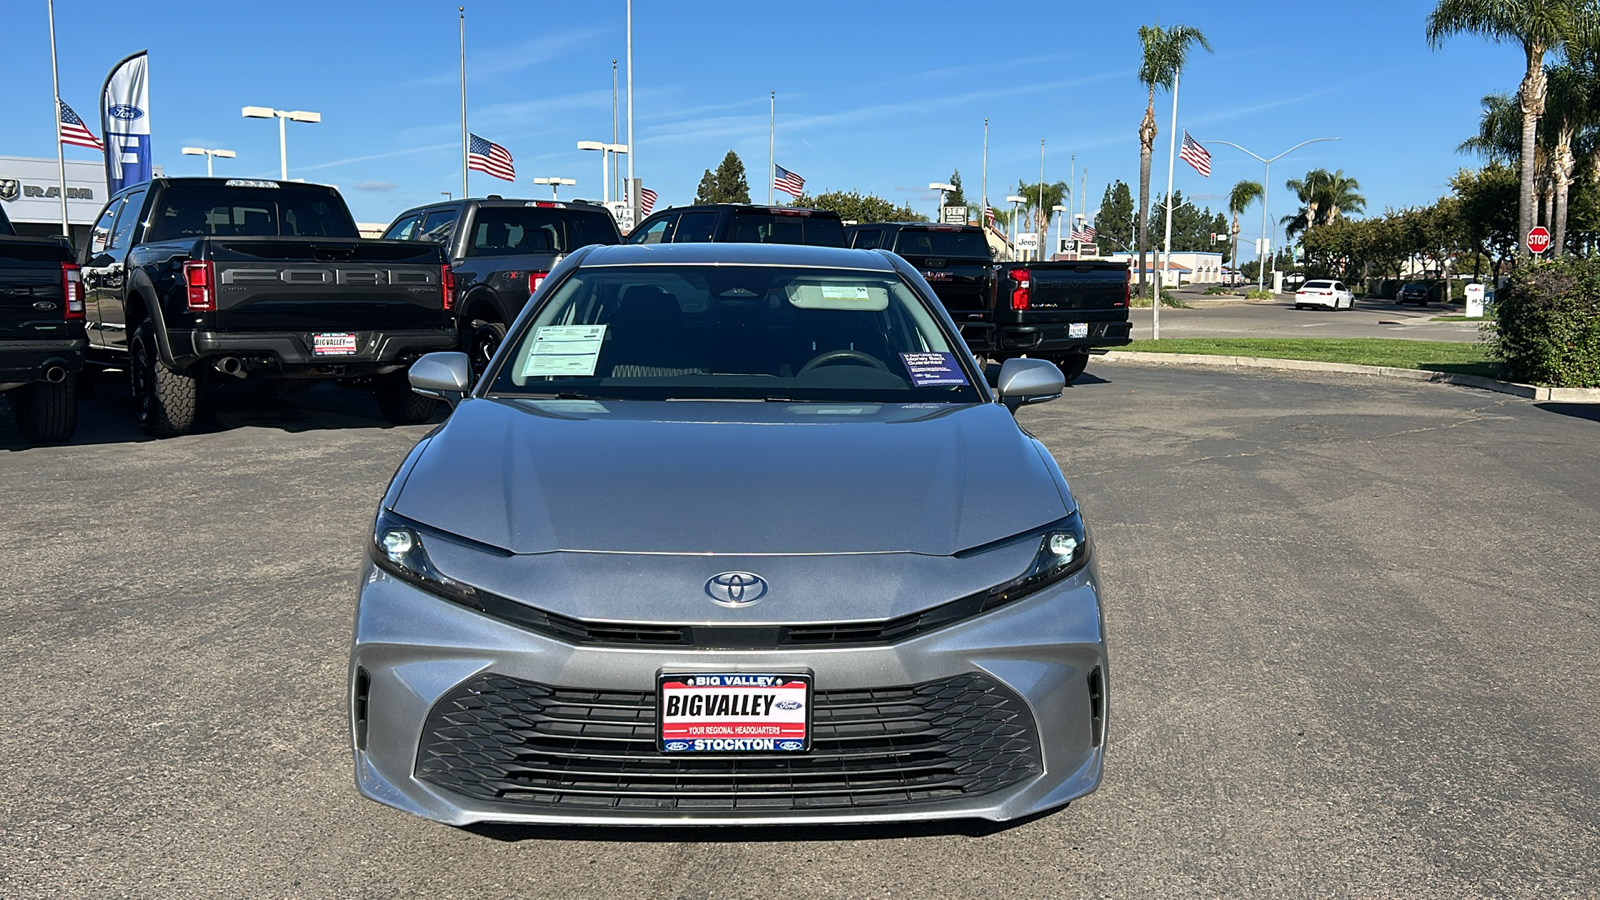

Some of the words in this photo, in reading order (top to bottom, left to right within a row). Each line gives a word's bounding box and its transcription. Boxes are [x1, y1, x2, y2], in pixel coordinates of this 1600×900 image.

[113, 105, 136, 119] Ford
[23, 185, 93, 200] RAM
[946, 207, 965, 215] OEM
[1528, 234, 1549, 245] STOP
[221, 268, 438, 285] FORD
[315, 338, 347, 346] BIGVALLEY
[696, 677, 721, 686] BIG
[724, 677, 775, 686] VALLEY
[666, 694, 776, 717] BIGVALLEY
[780, 700, 798, 709] Ford
[688, 727, 705, 735] YOUR
[706, 727, 734, 735] REGIONAL
[735, 726, 780, 735] HEADQUARTERS
[694, 739, 774, 750] STOCKTON
